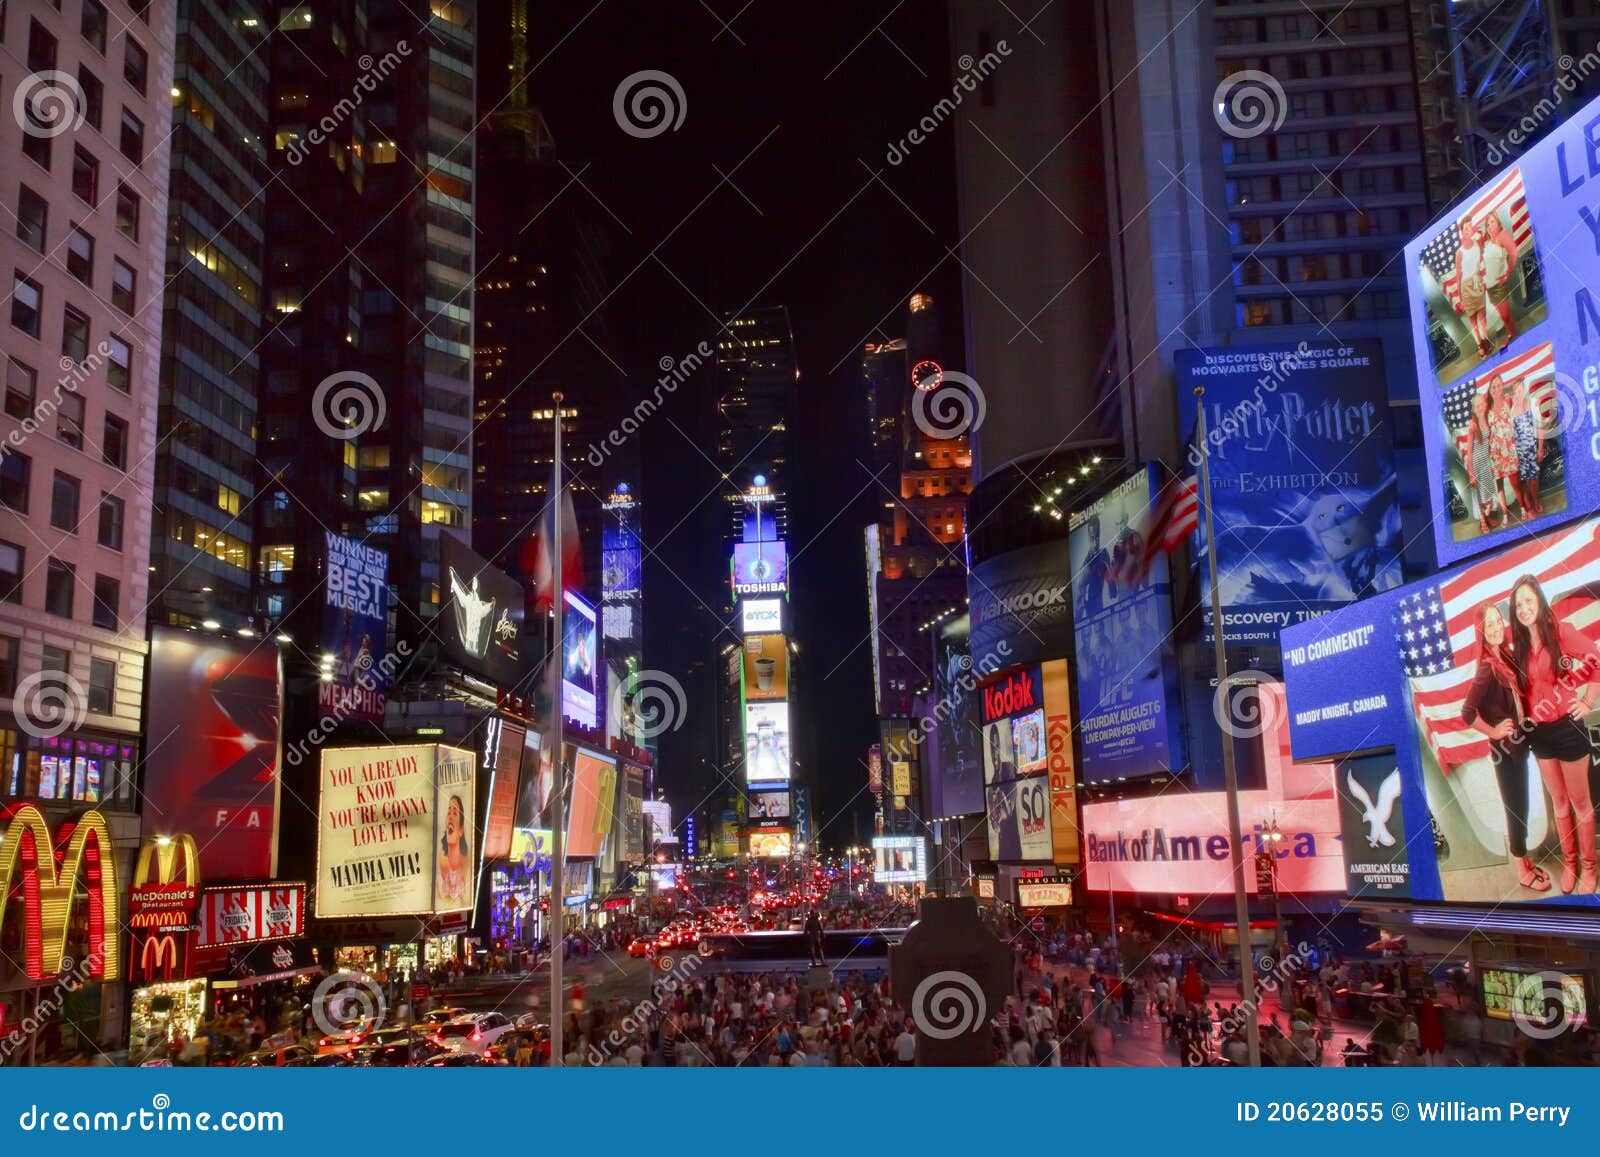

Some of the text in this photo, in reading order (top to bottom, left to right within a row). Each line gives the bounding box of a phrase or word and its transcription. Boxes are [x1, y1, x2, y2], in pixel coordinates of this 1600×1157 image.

[1192, 365, 1258, 376] HOGWARTS
[1320, 358, 1370, 369] SQUARE
[1205, 353, 1265, 365] DISCOVER
[1269, 351, 1292, 361] THE
[1338, 348, 1354, 357] OF
[1280, 392, 1376, 464] Potter
[750, 486, 769, 495] 2011
[1119, 467, 1147, 497] ORTIZ
[1212, 477, 1235, 489] THE
[744, 494, 776, 502] TOSHIBA
[1080, 497, 1105, 523] EVANS
[326, 531, 388, 569] WINNER!
[327, 563, 385, 604] BEST
[736, 582, 787, 594] TOSHIBA
[326, 590, 384, 620] MUSICAL
[1296, 609, 1332, 622] TIM
[1212, 633, 1241, 641] BOCKS
[1243, 632, 1270, 640] SOUTH
[319, 681, 386, 715] MEMPHIS
[984, 671, 1035, 721] Kodak
[1101, 677, 1135, 707] UFC
[1080, 711, 1120, 733] SATURDAY,
[1120, 701, 1154, 723] AUGUST
[1154, 700, 1161, 714] 6
[1297, 695, 1388, 726] MADDY KNIGHT, CANADA
[1085, 730, 1100, 744] LIVE
[329, 755, 419, 787] YOU ALREADY
[1047, 714, 1072, 810] Kodak
[356, 780, 398, 804] KNOW
[329, 796, 428, 830] YOU'RE GONNA
[1023, 817, 1045, 835] Kodak
[352, 818, 409, 847] LOVE IT!
[1087, 831, 1128, 862] Bank
[1132, 829, 1151, 862] of
[330, 859, 386, 889] MAMMA
[388, 852, 422, 879] MIA!
[1018, 877, 1073, 885] MARQUIS
[1350, 863, 1410, 874] AMERICAN EAG
[1363, 874, 1404, 883] OUTFITTERS
[131, 890, 195, 902] McDonald's
[142, 901, 184, 909] Restaurant
